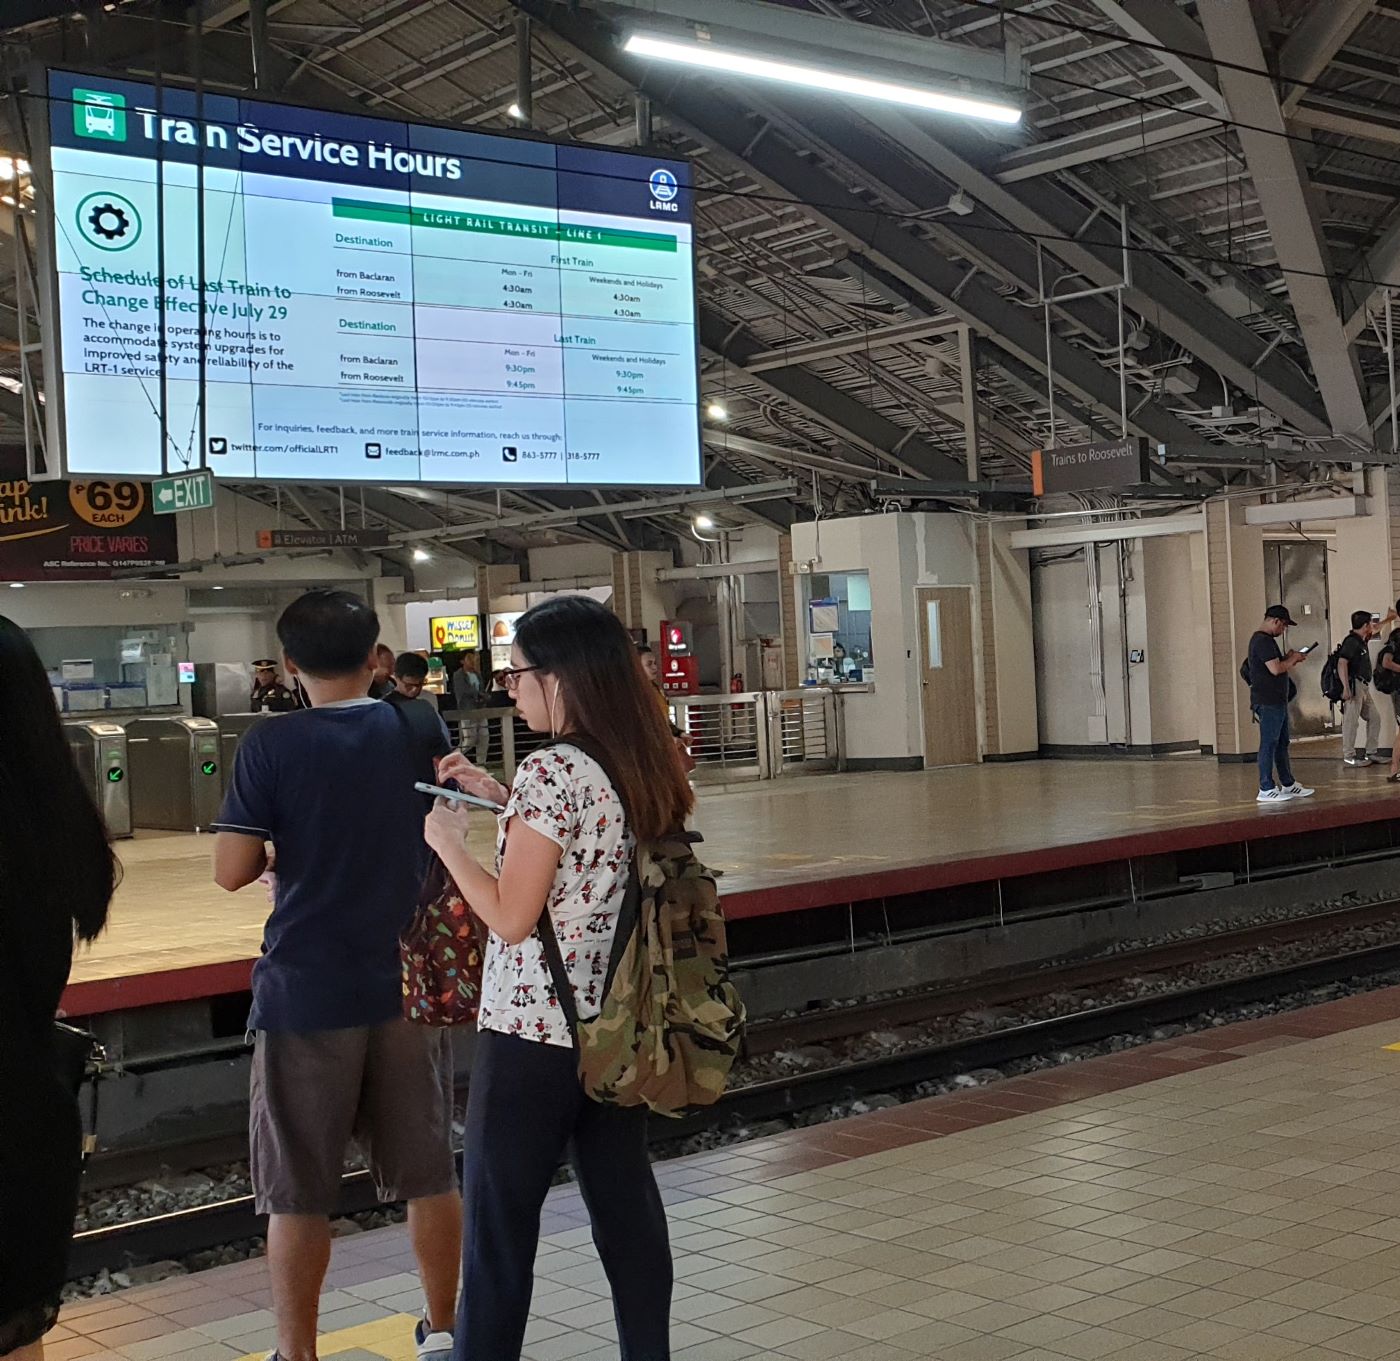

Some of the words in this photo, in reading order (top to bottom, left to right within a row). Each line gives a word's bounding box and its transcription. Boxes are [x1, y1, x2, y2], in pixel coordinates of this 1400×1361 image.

[135, 106, 228, 148] Tran
[237, 123, 359, 167] Service
[368, 140, 462, 180] Hours
[650, 200, 679, 212] LRMC
[424, 212, 460, 226] LIGHT
[466, 217, 494, 229] RAIL
[500, 221, 549, 235] TRANSIT
[566, 228, 592, 239] LINE
[335, 233, 393, 248] Destination
[551, 255, 571, 266] First
[573, 257, 594, 267] Train
[336, 269, 357, 280] from
[359, 272, 395, 282] Baclaran
[501, 268, 517, 276] Mon
[80, 266, 161, 288] Schedule
[167, 275, 184, 290] of
[227, 280, 271, 297] Train
[274, 285, 291, 299] to
[502, 284, 533, 294] 4:30am
[589, 276, 622, 286] Weekends
[624, 279, 635, 287] and
[636, 280, 664, 290] Holidays
[337, 286, 358, 295] from
[360, 288, 401, 299] Roosevelt
[613, 293, 641, 303] 4:30am
[82, 290, 149, 312] Change
[154, 295, 228, 315] Effecive
[232, 302, 263, 322] July
[268, 305, 287, 319] 29
[503, 300, 533, 309] 4:30am
[614, 309, 641, 318] 4:30am
[82, 317, 106, 328] The
[109, 319, 151, 334] change
[167, 326, 221, 339] operang
[224, 328, 256, 340] hours
[259, 331, 267, 340] is
[270, 332, 281, 341] to
[339, 318, 396, 332] Destination
[83, 334, 167, 348] accommoda
[215, 343, 266, 355] upgrades
[269, 345, 285, 355] for
[553, 334, 572, 344] Last
[574, 335, 596, 346] Train
[145, 352, 180, 366] saty
[183, 356, 203, 365] an
[208, 356, 260, 371] reliability
[263, 360, 275, 369] of
[277, 360, 295, 371] the
[340, 354, 360, 363] from
[363, 356, 398, 366] Baclaran
[592, 354, 624, 363] Weekends
[626, 355, 638, 364] and
[639, 357, 666, 366] Holidays
[85, 362, 118, 373] LRT-1
[341, 371, 361, 380] from
[363, 373, 404, 383] Roosevelt
[258, 423, 273, 431] For
[316, 425, 358, 435] feedback,
[360, 427, 375, 435] and
[377, 428, 399, 436] more
[400, 428, 419, 436] train
[421, 430, 448, 438] service
[499, 432, 520, 440] reach
[532, 432, 562, 442] through:
[1051, 453, 1075, 467] Trains
[1078, 452, 1087, 463] to
[1088, 443, 1134, 462] Roosevelt
[174, 475, 206, 508] EXIT
[92, 514, 125, 524] EACH
[70, 536, 104, 553] PRICE
[108, 536, 149, 553] VARIES
[335, 534, 358, 545] ATM
